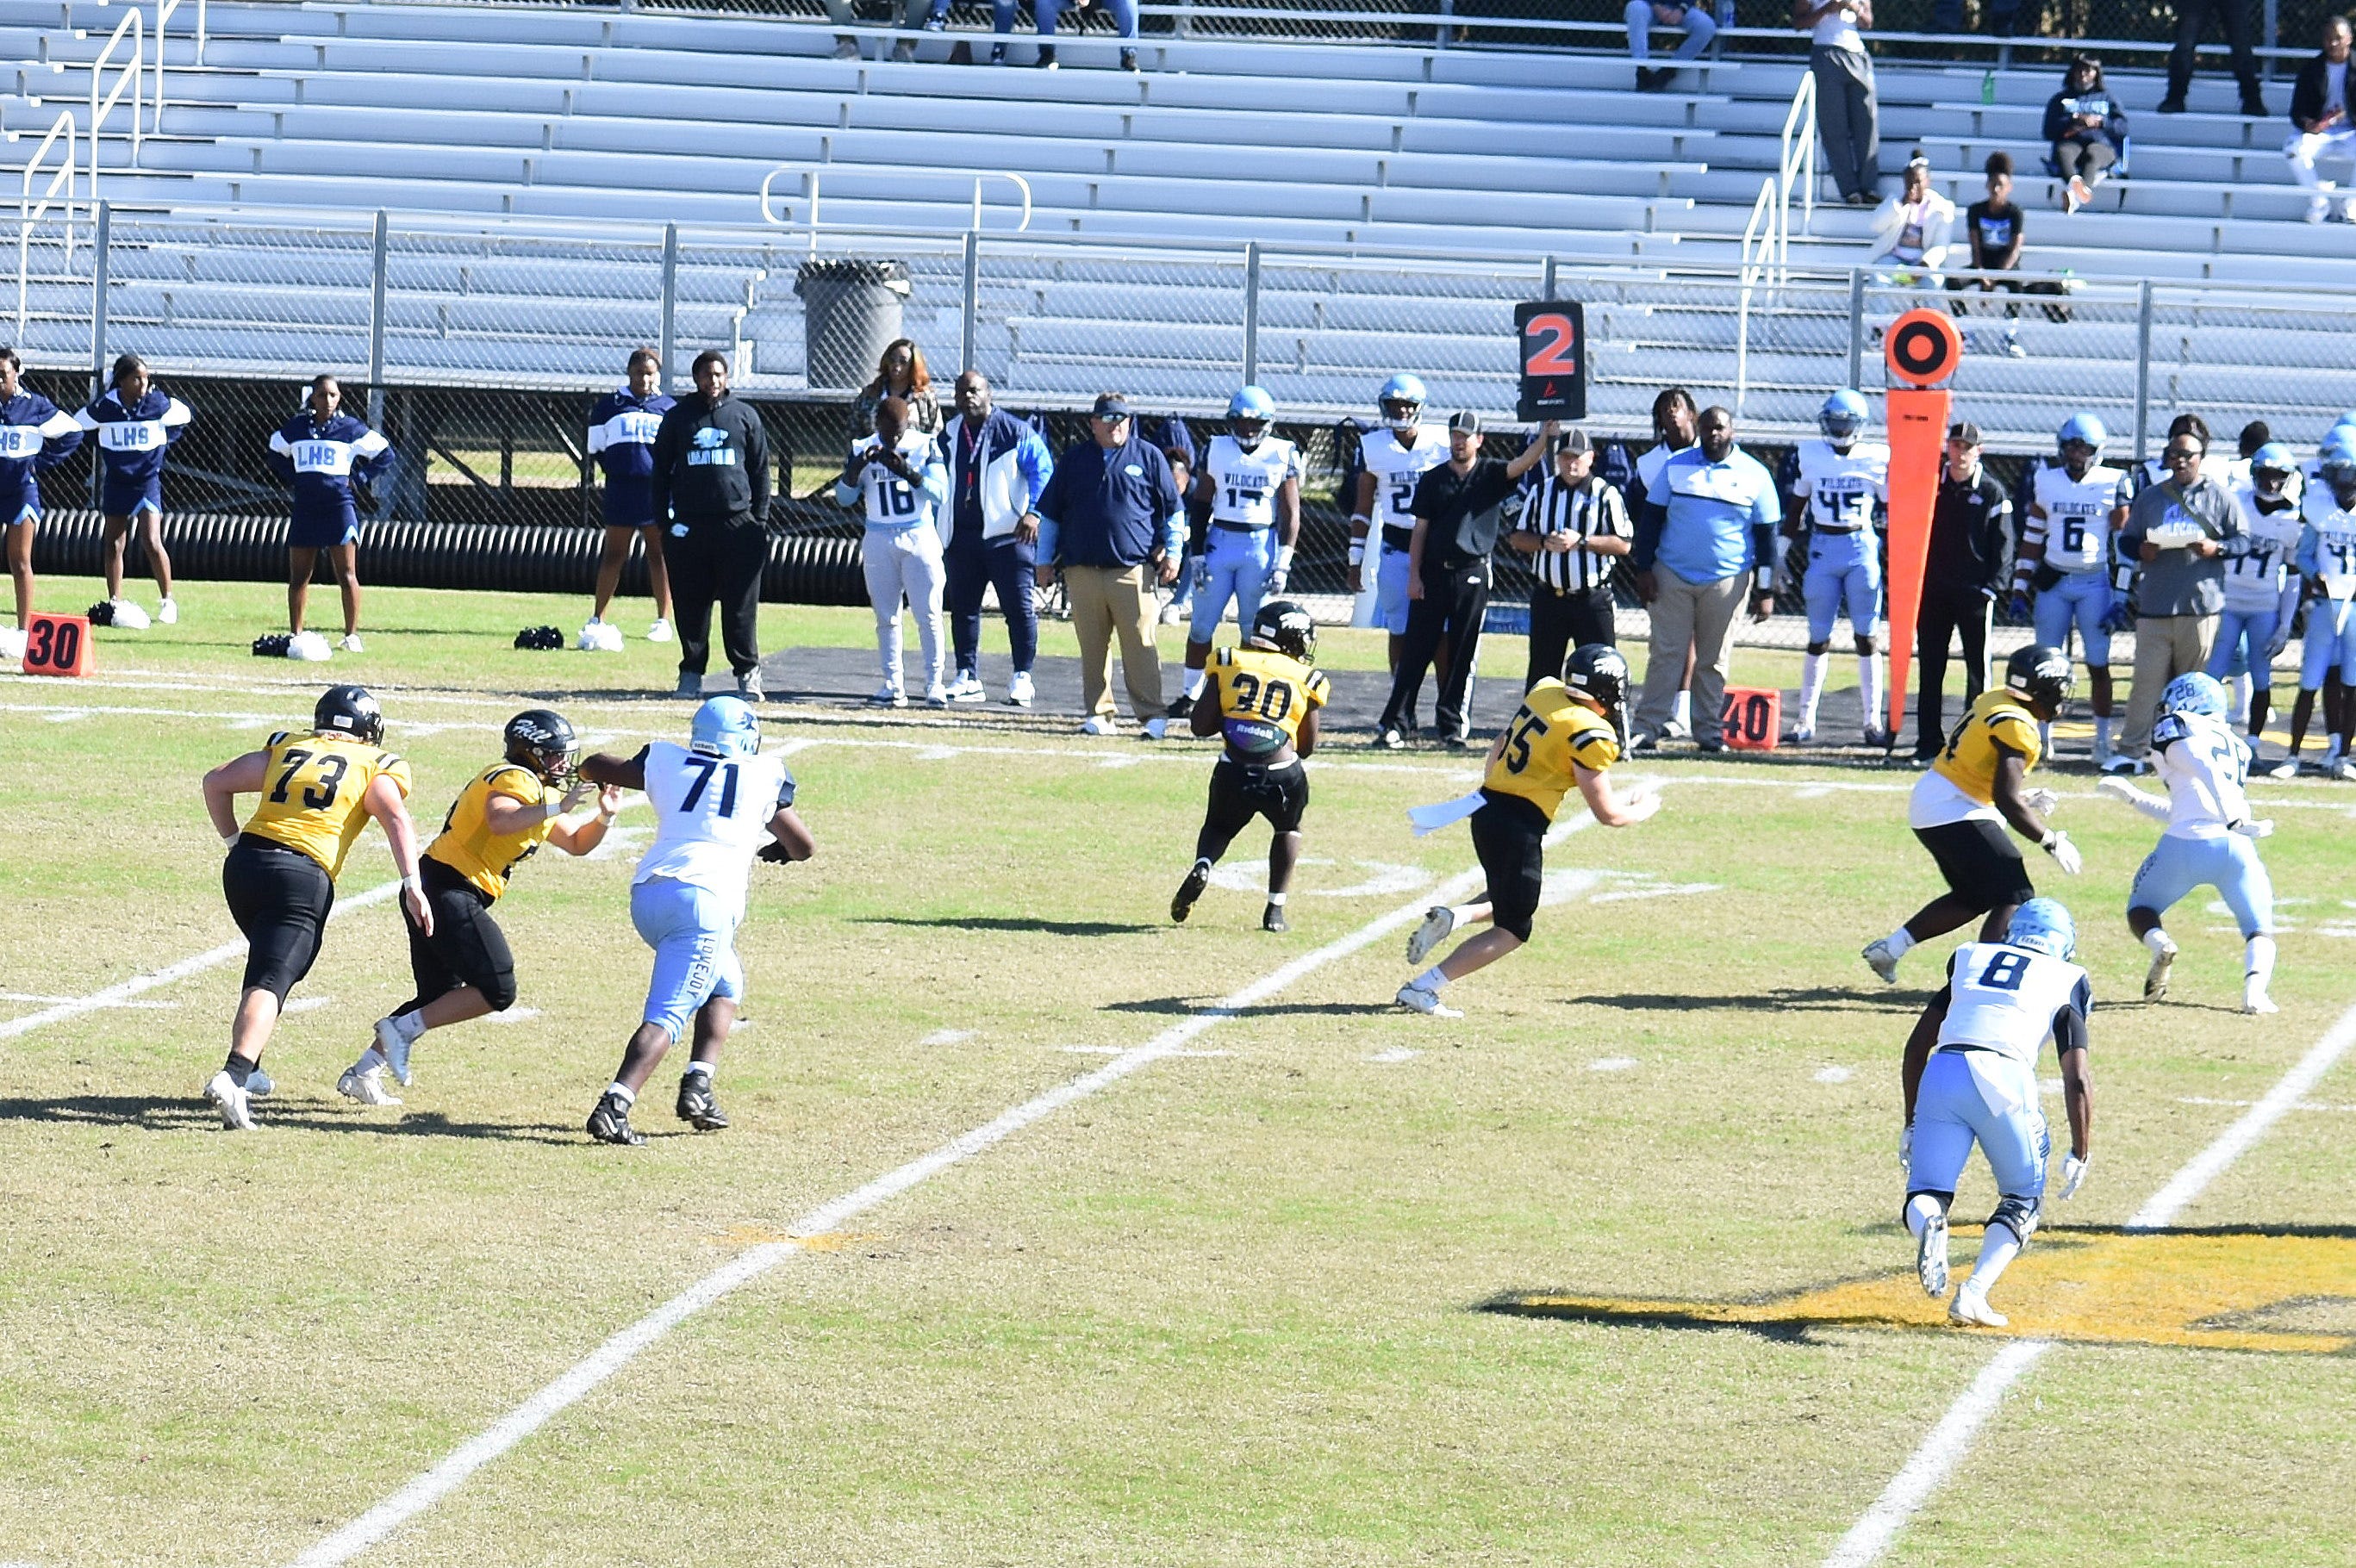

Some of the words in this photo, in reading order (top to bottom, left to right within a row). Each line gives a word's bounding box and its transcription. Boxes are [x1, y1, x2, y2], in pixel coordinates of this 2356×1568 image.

[1525, 314, 1574, 376] 2
[0, 432, 20, 451] HS
[112, 427, 148, 445] LHS
[297, 446, 336, 465] LHS
[1225, 473, 1269, 488] WILDCATS
[877, 481, 915, 516] 16
[1390, 484, 1418, 514] 2
[1817, 490, 1865, 522] 45
[2063, 517, 2085, 552] 6
[28, 619, 79, 669] 30
[1230, 672, 1292, 722] 30
[2175, 682, 2195, 701] 28
[1237, 725, 1274, 740] Riddell
[1720, 693, 1770, 741] 40
[269, 749, 348, 811] 73
[678, 756, 739, 818] 71
[687, 937, 716, 999] LOVEJOY
[1979, 950, 2032, 991] 8
